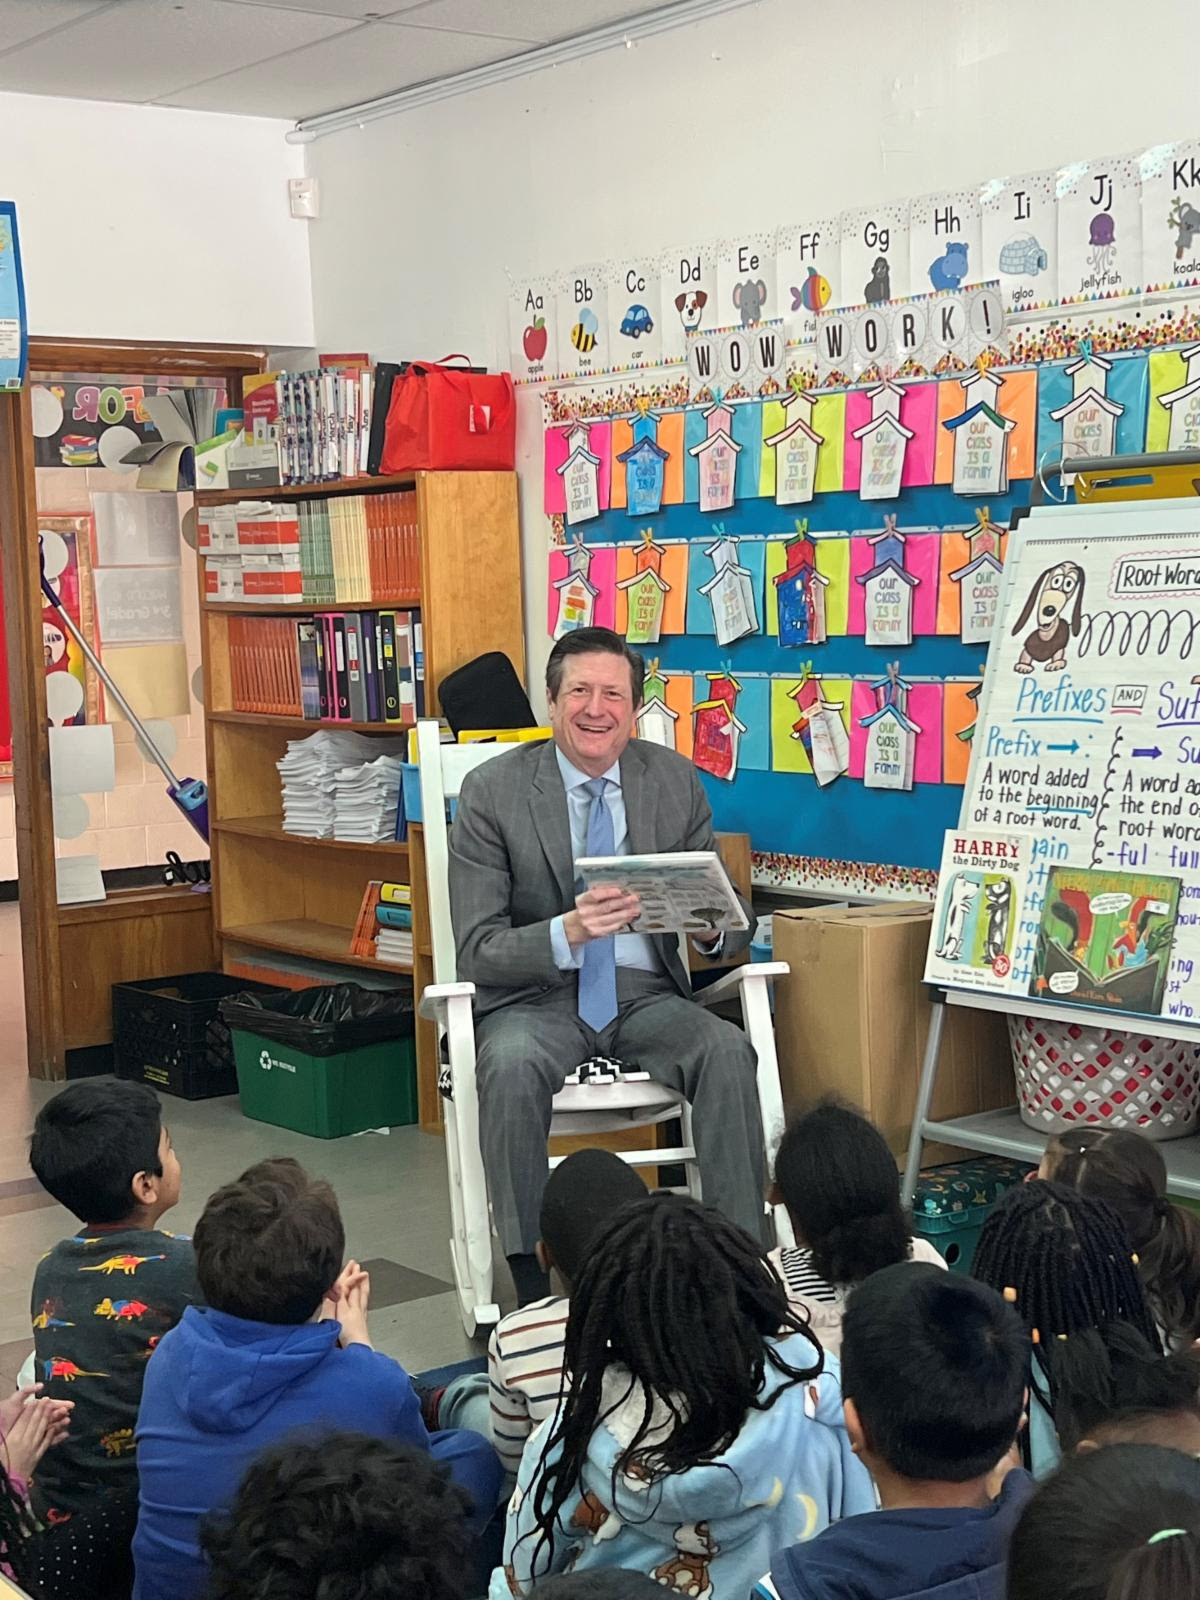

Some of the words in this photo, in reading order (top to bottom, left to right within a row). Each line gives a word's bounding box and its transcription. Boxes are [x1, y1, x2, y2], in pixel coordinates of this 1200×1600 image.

[1090, 174, 1113, 211] Jj
[1014, 192, 1031, 220] Ii
[935, 206, 960, 235] Hh
[800, 233, 820, 261] Ff
[864, 221, 889, 252] Gg
[680, 257, 701, 284] Dd
[738, 247, 759, 272] Ee
[574, 279, 593, 303] Bb
[626, 270, 645, 293] Cc
[1080, 272, 1122, 292] jellyfish
[525, 289, 544, 311] Aa
[1012, 288, 1034, 302] igloo
[579, 356, 592, 367] bee
[631, 349, 644, 359] car
[695, 327, 776, 376] WOW
[527, 364, 544, 374] apple
[1124, 564, 1160, 587] Root
[1016, 674, 1108, 713] Prefixes
[1117, 688, 1143, 701] AND
[986, 726, 1042, 757] Prefix
[982, 762, 993, 783] A
[998, 765, 1040, 786] word
[1046, 767, 1088, 788] added
[1123, 771, 1133, 793] A
[1140, 773, 1178, 794] word
[978, 784, 994, 801] to
[998, 785, 1023, 803] the
[1026, 789, 1099, 818] beginning
[1119, 793, 1147, 815] the
[1151, 795, 1185, 816] end
[1188, 800, 1200, 816] o
[973, 807, 987, 823] of
[993, 809, 1001, 823] a
[1006, 810, 1036, 825] root
[1042, 814, 1081, 831] word.
[1118, 820, 1156, 838] root
[954, 838, 1020, 859] HARRY
[953, 855, 968, 866] the
[971, 856, 997, 869] Dirty
[1000, 859, 1020, 872] Dog
[1171, 960, 1194, 983] ing
